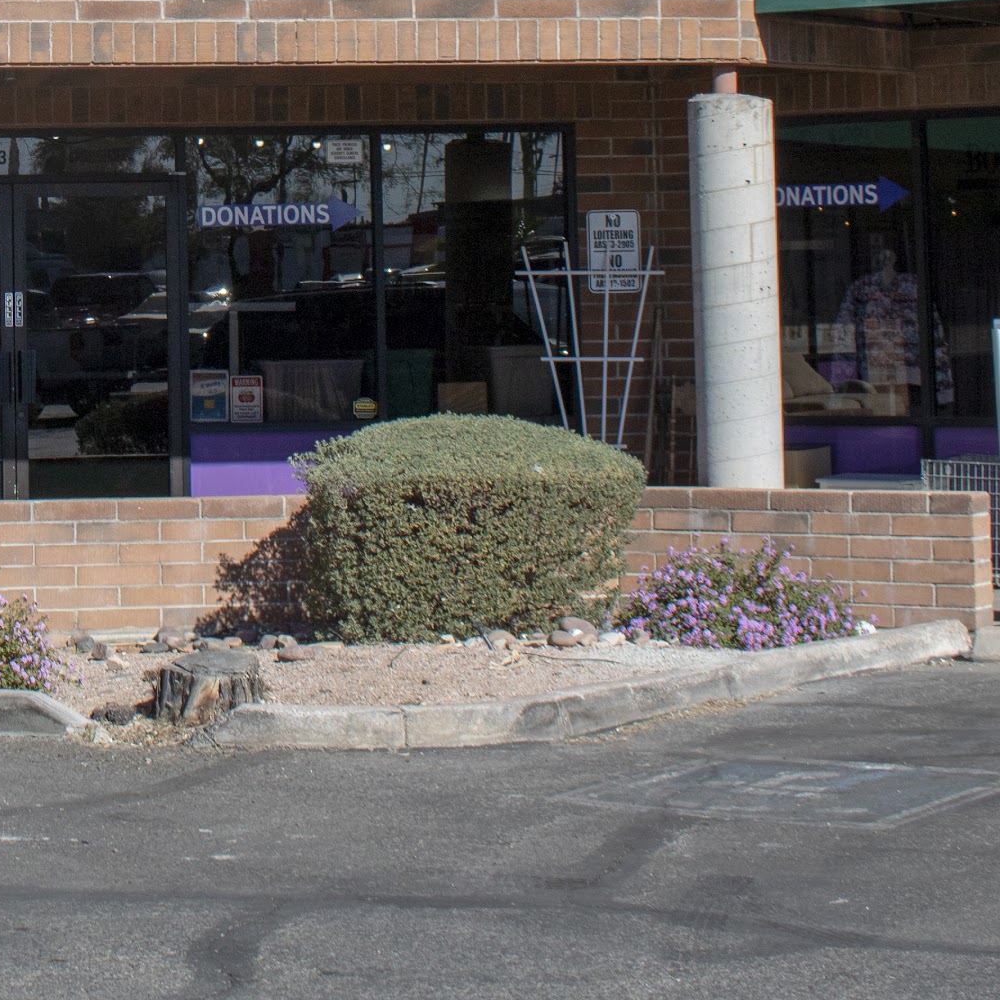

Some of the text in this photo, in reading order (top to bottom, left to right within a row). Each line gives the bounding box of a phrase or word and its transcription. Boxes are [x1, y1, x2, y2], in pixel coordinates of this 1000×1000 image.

[776, 184, 879, 206] ONATIONS
[201, 203, 330, 227] DONATIONS
[605, 214, 621, 228] NO
[593, 230, 634, 240] LOITERING
[608, 240, 635, 248] 3-2905
